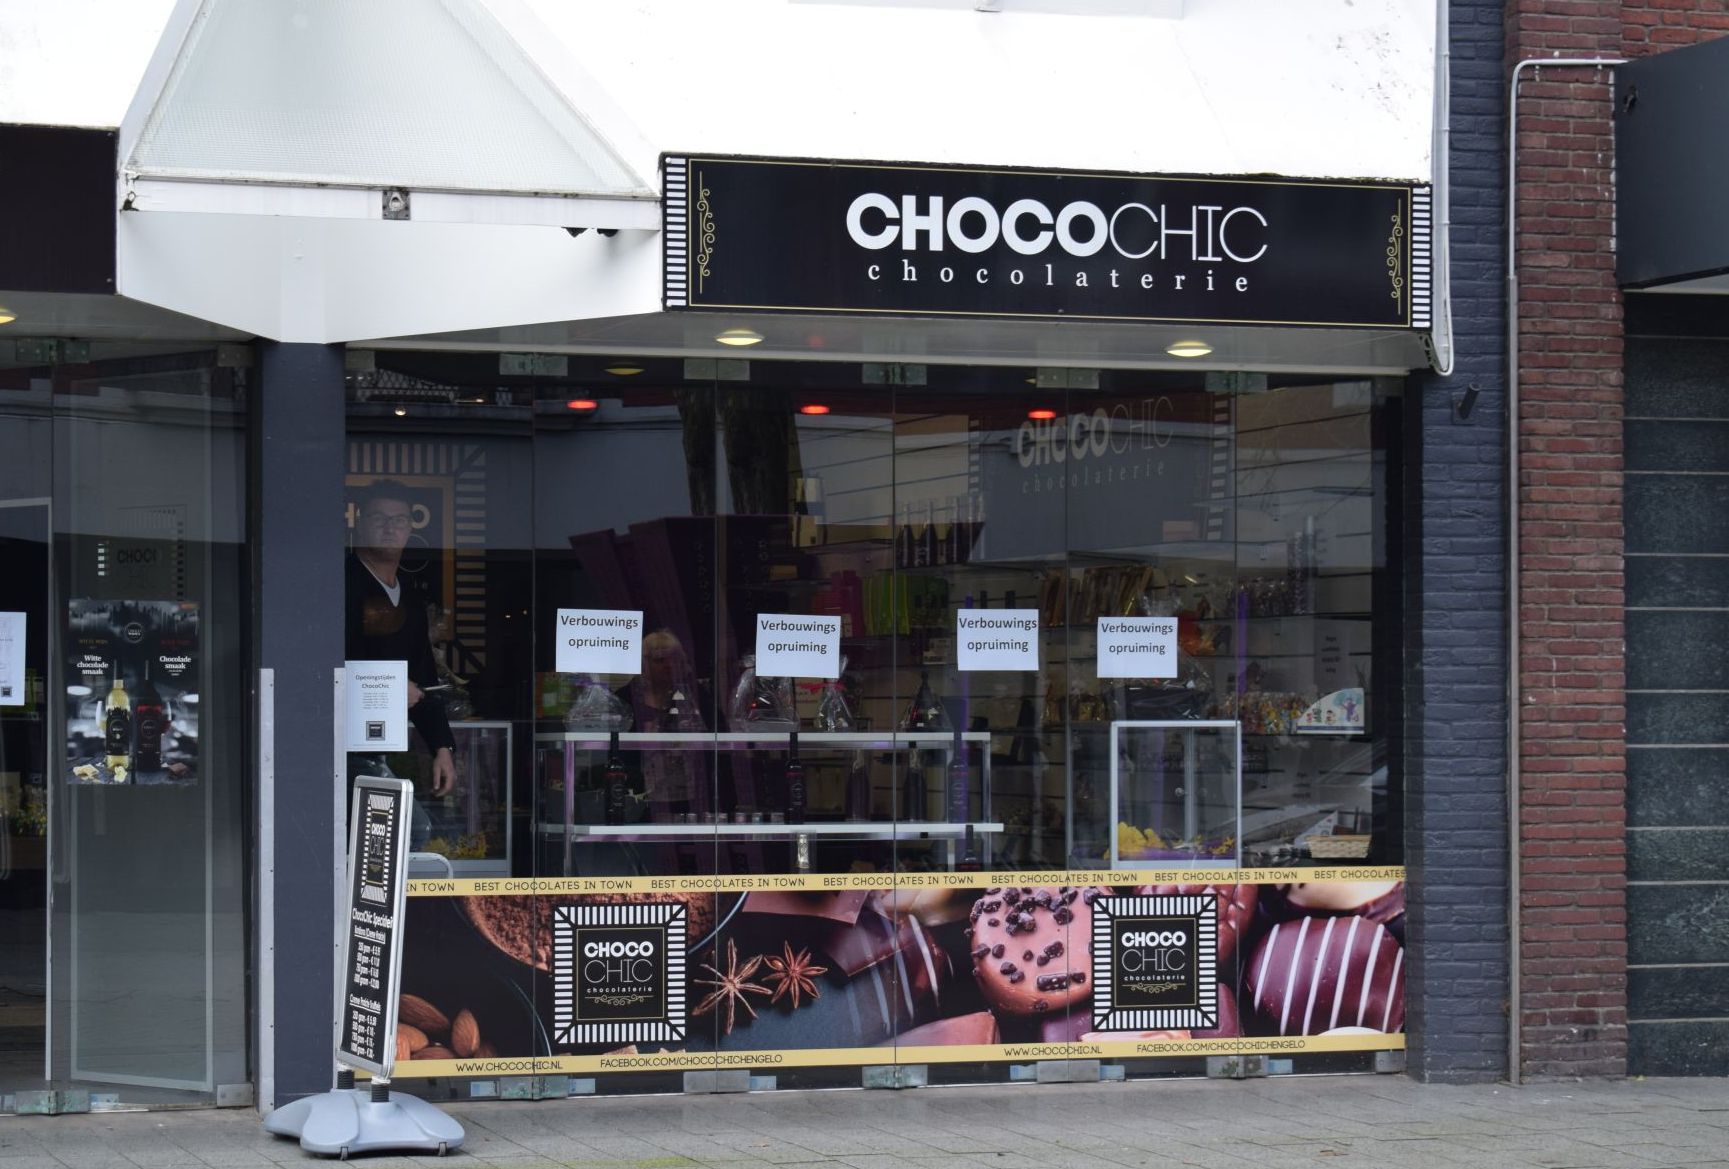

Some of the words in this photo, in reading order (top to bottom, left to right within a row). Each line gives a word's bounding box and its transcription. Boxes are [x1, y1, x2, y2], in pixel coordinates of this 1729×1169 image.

[868, 259, 1248, 292] chocolaterie
[561, 615, 638, 629] Verbouwings
[761, 620, 836, 633] Verbouwings
[959, 617, 1037, 631] Verbouwings
[1101, 622, 1173, 635] Verbouwings
[568, 637, 629, 650] opruiming
[768, 641, 827, 654] opruiming
[967, 639, 1029, 652] opruiming
[1109, 642, 1165, 655] opruiming
[83, 654, 102, 662] Witte
[159, 655, 192, 663] Chocolade
[77, 661, 109, 669] chocolade
[165, 662, 186, 670] smaak
[823, 877, 847, 886] BEST
[851, 876, 924, 886] CHOCOLATES
[928, 876, 939, 884] IN
[943, 875, 974, 884] TOWN
[991, 875, 1016, 883] BEST
[1019, 873, 1088, 883] CHOCOLATES
[1092, 874, 1103, 882] IN
[1108, 873, 1138, 882] TOWN
[1154, 872, 1178, 881] BEST
[1182, 871, 1250, 881] CHOCOLATES
[1254, 871, 1265, 880] IN
[1269, 871, 1297, 880] TOWN
[1314, 870, 1336, 879] BEST
[422, 882, 455, 892] TOWN
[474, 882, 500, 891] BEST
[504, 880, 580, 891] CHOCOLATES
[584, 880, 596, 890] IN
[600, 879, 633, 890] TOWN
[651, 879, 676, 889] BEST
[680, 878, 754, 888] CHOCOLATES
[758, 878, 770, 887] IN
[774, 877, 805, 887] TOWN
[1121, 931, 1186, 947] CHOCO
[584, 941, 654, 958] CHOCO
[1121, 948, 1186, 972] CHIC
[584, 958, 653, 983] CHIC
[586, 986, 652, 994] chocolaterie
[1004, 1045, 1102, 1056] WWW.CHOCOCHIC.NL
[1137, 1040, 1306, 1053] FACEBOOK.COM/CHOCOCHICHENGELO
[456, 1060, 563, 1072] WWW.CHOCOCHIC.NL
[600, 1054, 783, 1068] FACEBOOK.COM/CHOCOCHICHENGELO
